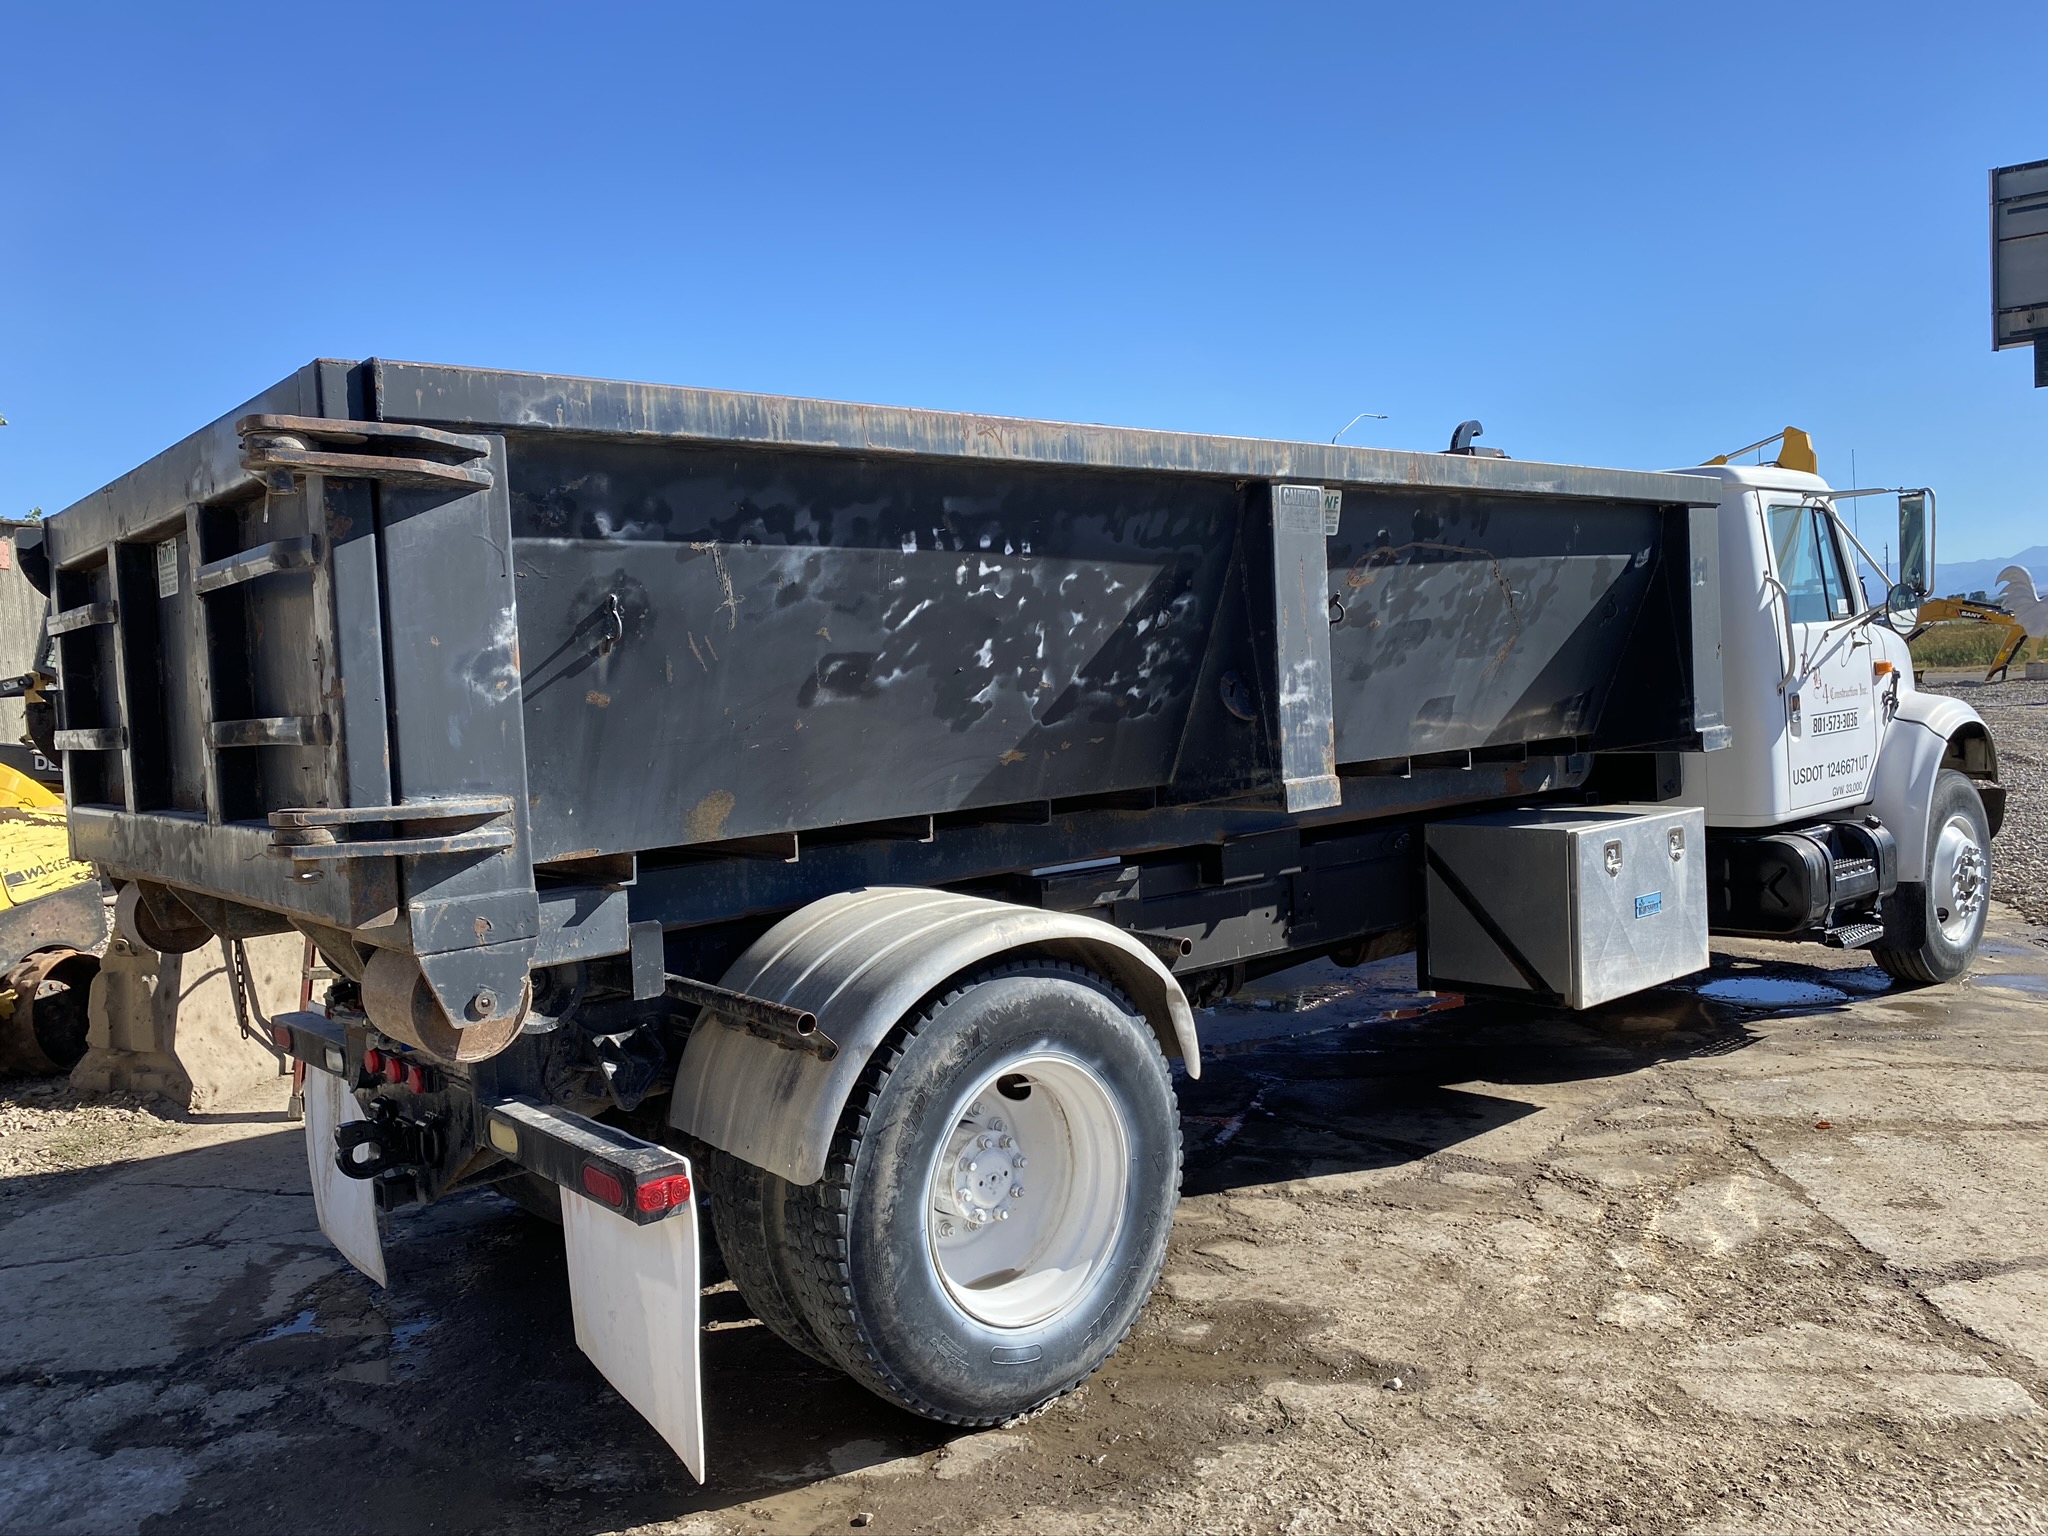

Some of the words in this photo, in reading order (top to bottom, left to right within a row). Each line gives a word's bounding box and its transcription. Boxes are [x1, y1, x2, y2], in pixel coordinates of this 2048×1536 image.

[1283, 488, 1318, 506] CAUTION
[1961, 611, 1982, 619] SANY
[1812, 711, 1858, 733] 801-573-3036
[1792, 764, 1824, 786] USDOT
[1832, 785, 1844, 797] GVW
[1845, 781, 1863, 794] 33,000
